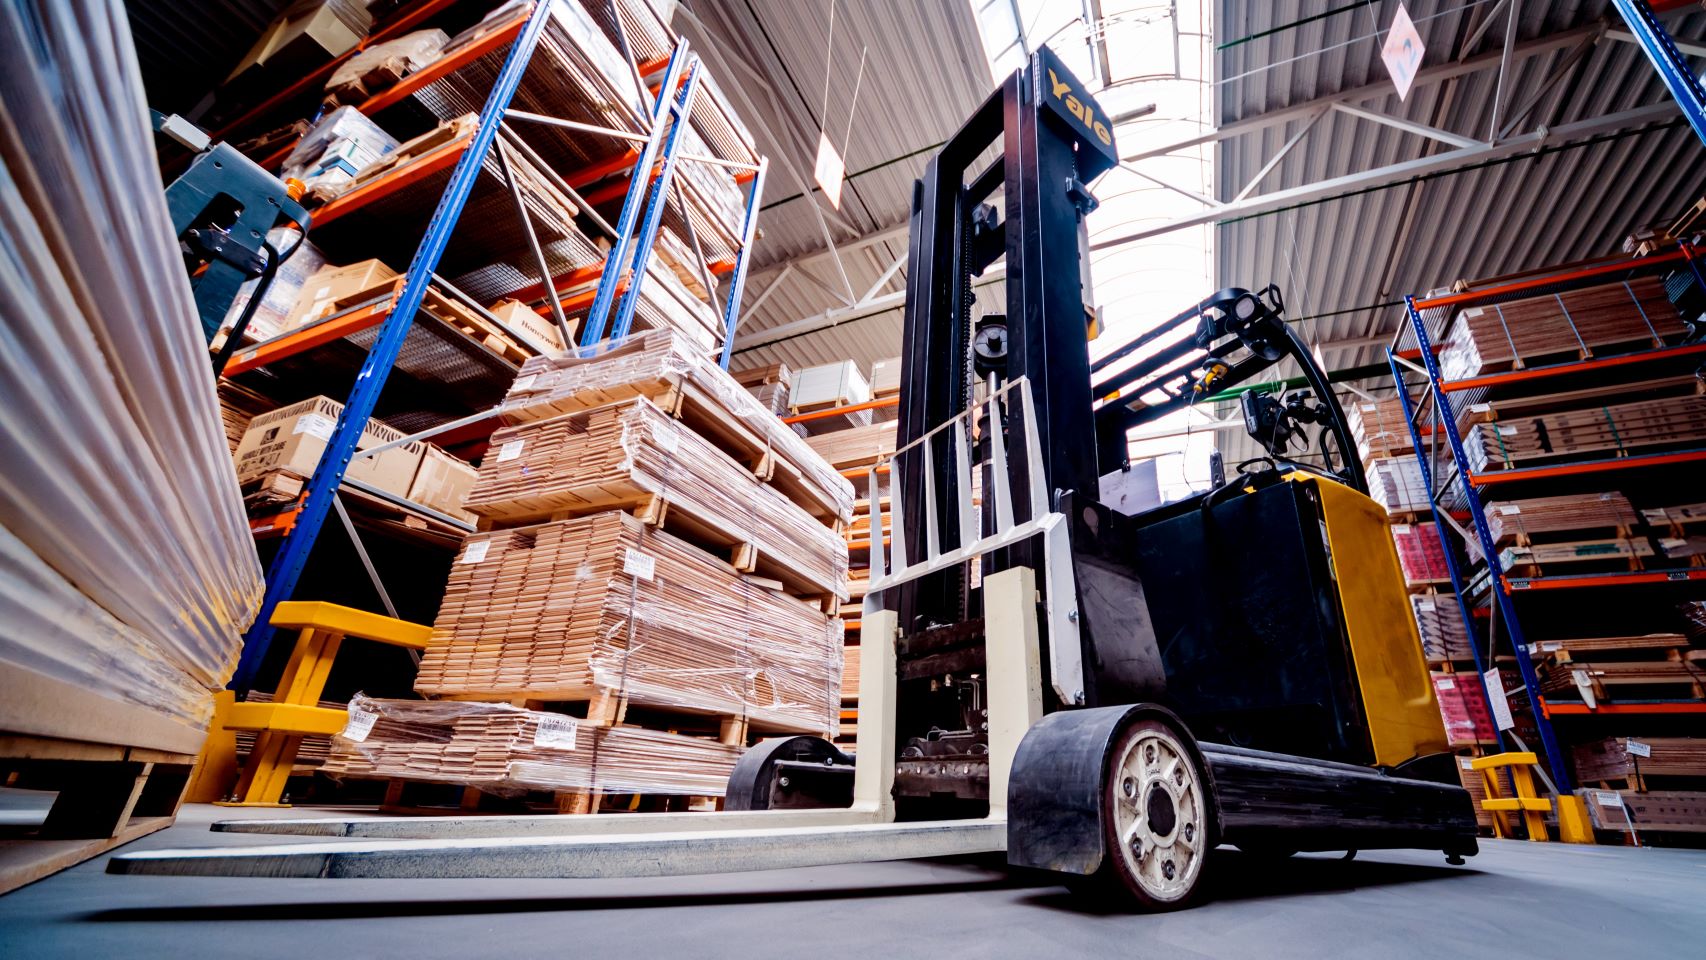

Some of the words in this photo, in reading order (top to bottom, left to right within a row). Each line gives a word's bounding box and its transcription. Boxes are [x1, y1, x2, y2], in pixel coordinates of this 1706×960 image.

[1048, 67, 1112, 146] Yale
[521, 319, 560, 349] Honeywell
[272, 440, 287, 452] CARE
